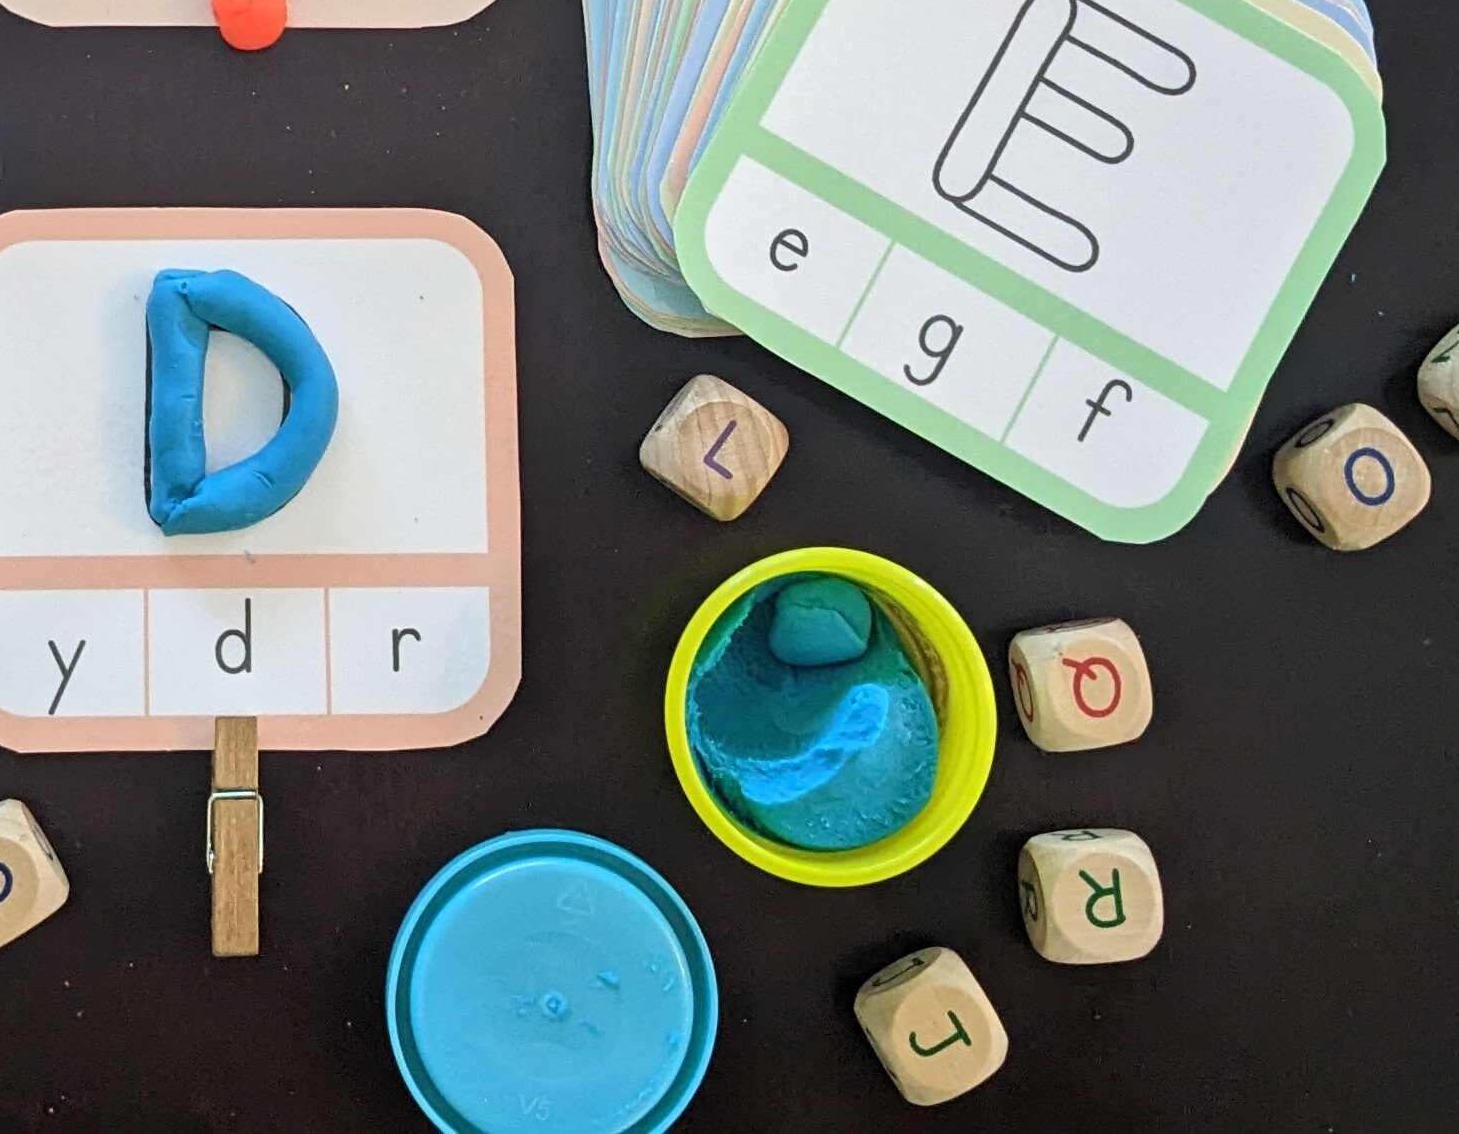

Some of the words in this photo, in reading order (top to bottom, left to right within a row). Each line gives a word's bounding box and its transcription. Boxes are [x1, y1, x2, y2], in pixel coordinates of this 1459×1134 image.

[768, 228, 810, 272] e
[902, 314, 965, 386] g
[144, 268, 339, 536] D
[1077, 379, 1133, 443] f
[703, 420, 737, 479] L
[1344, 447, 1395, 506] O
[214, 598, 252, 674] d
[391, 628, 421, 672] r
[47, 639, 86, 715] y
[1062, 656, 1122, 718] Q
[1079, 868, 1126, 928] R
[909, 1010, 972, 1057] J
